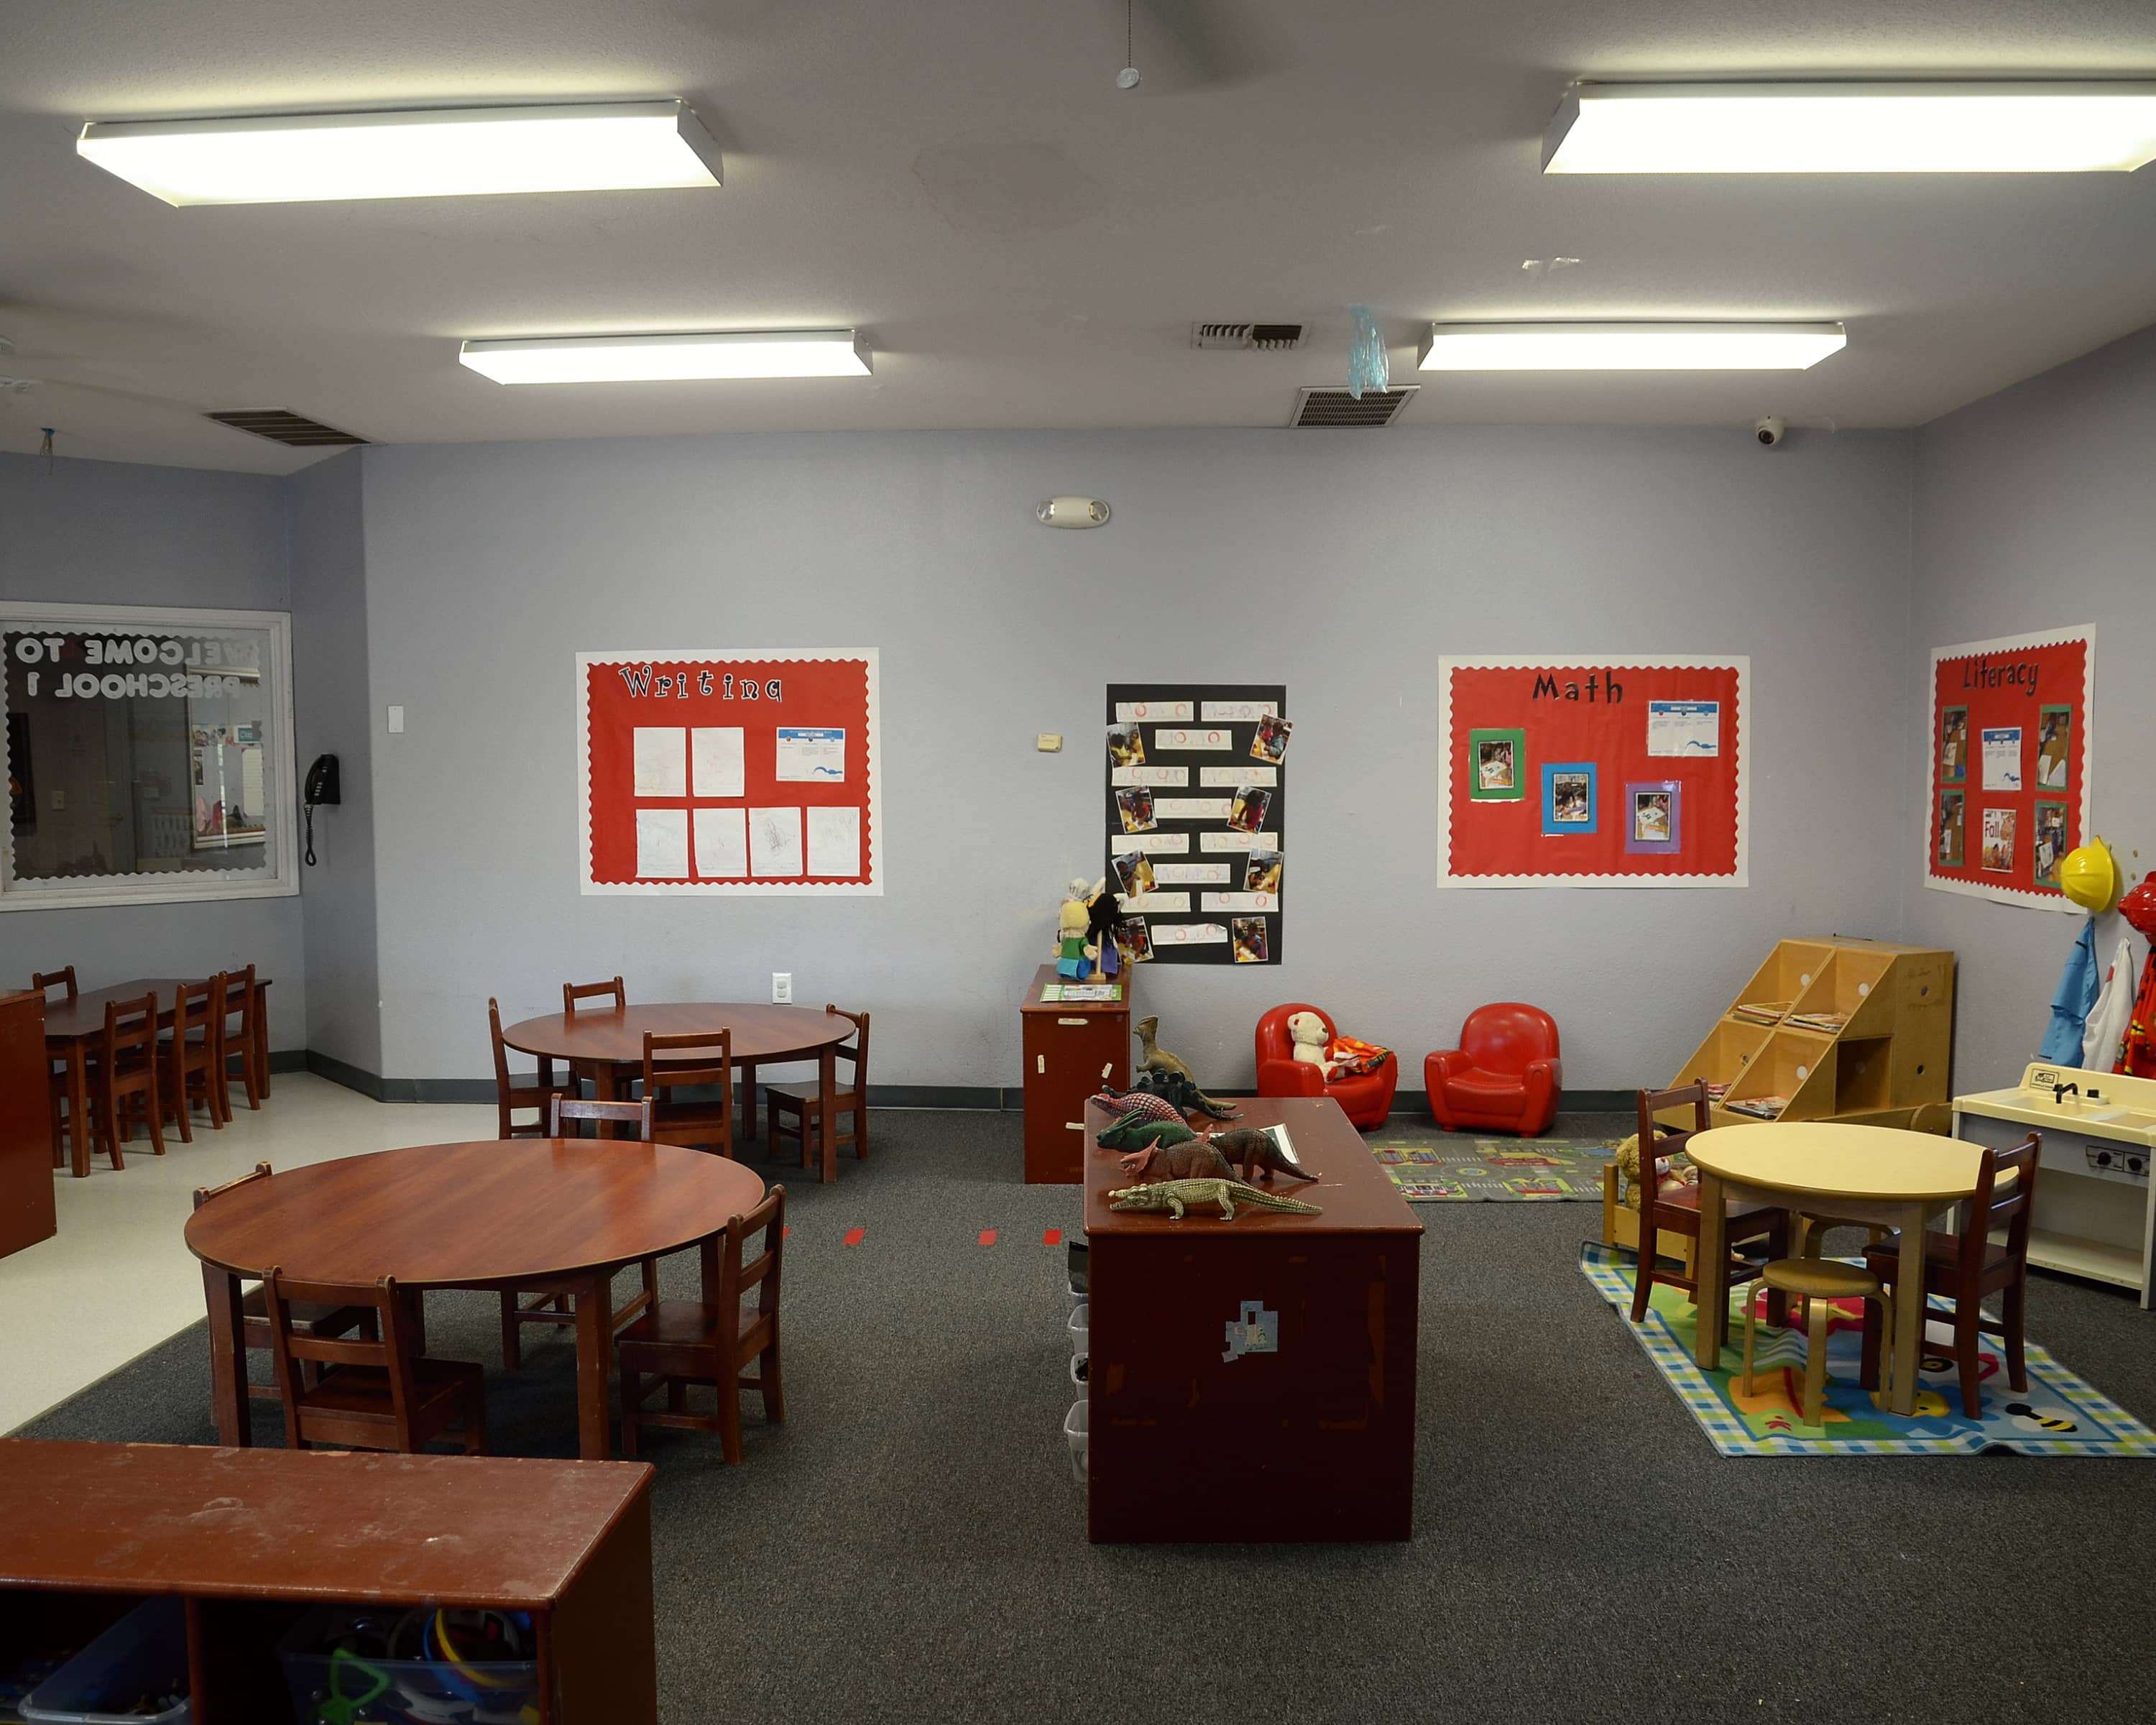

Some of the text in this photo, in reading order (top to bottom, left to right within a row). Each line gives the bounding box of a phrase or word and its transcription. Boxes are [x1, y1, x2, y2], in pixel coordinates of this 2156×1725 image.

[1532, 670, 1623, 704] Math
[1963, 657, 2039, 696] Literacy
[1985, 821, 2000, 838] Fall
